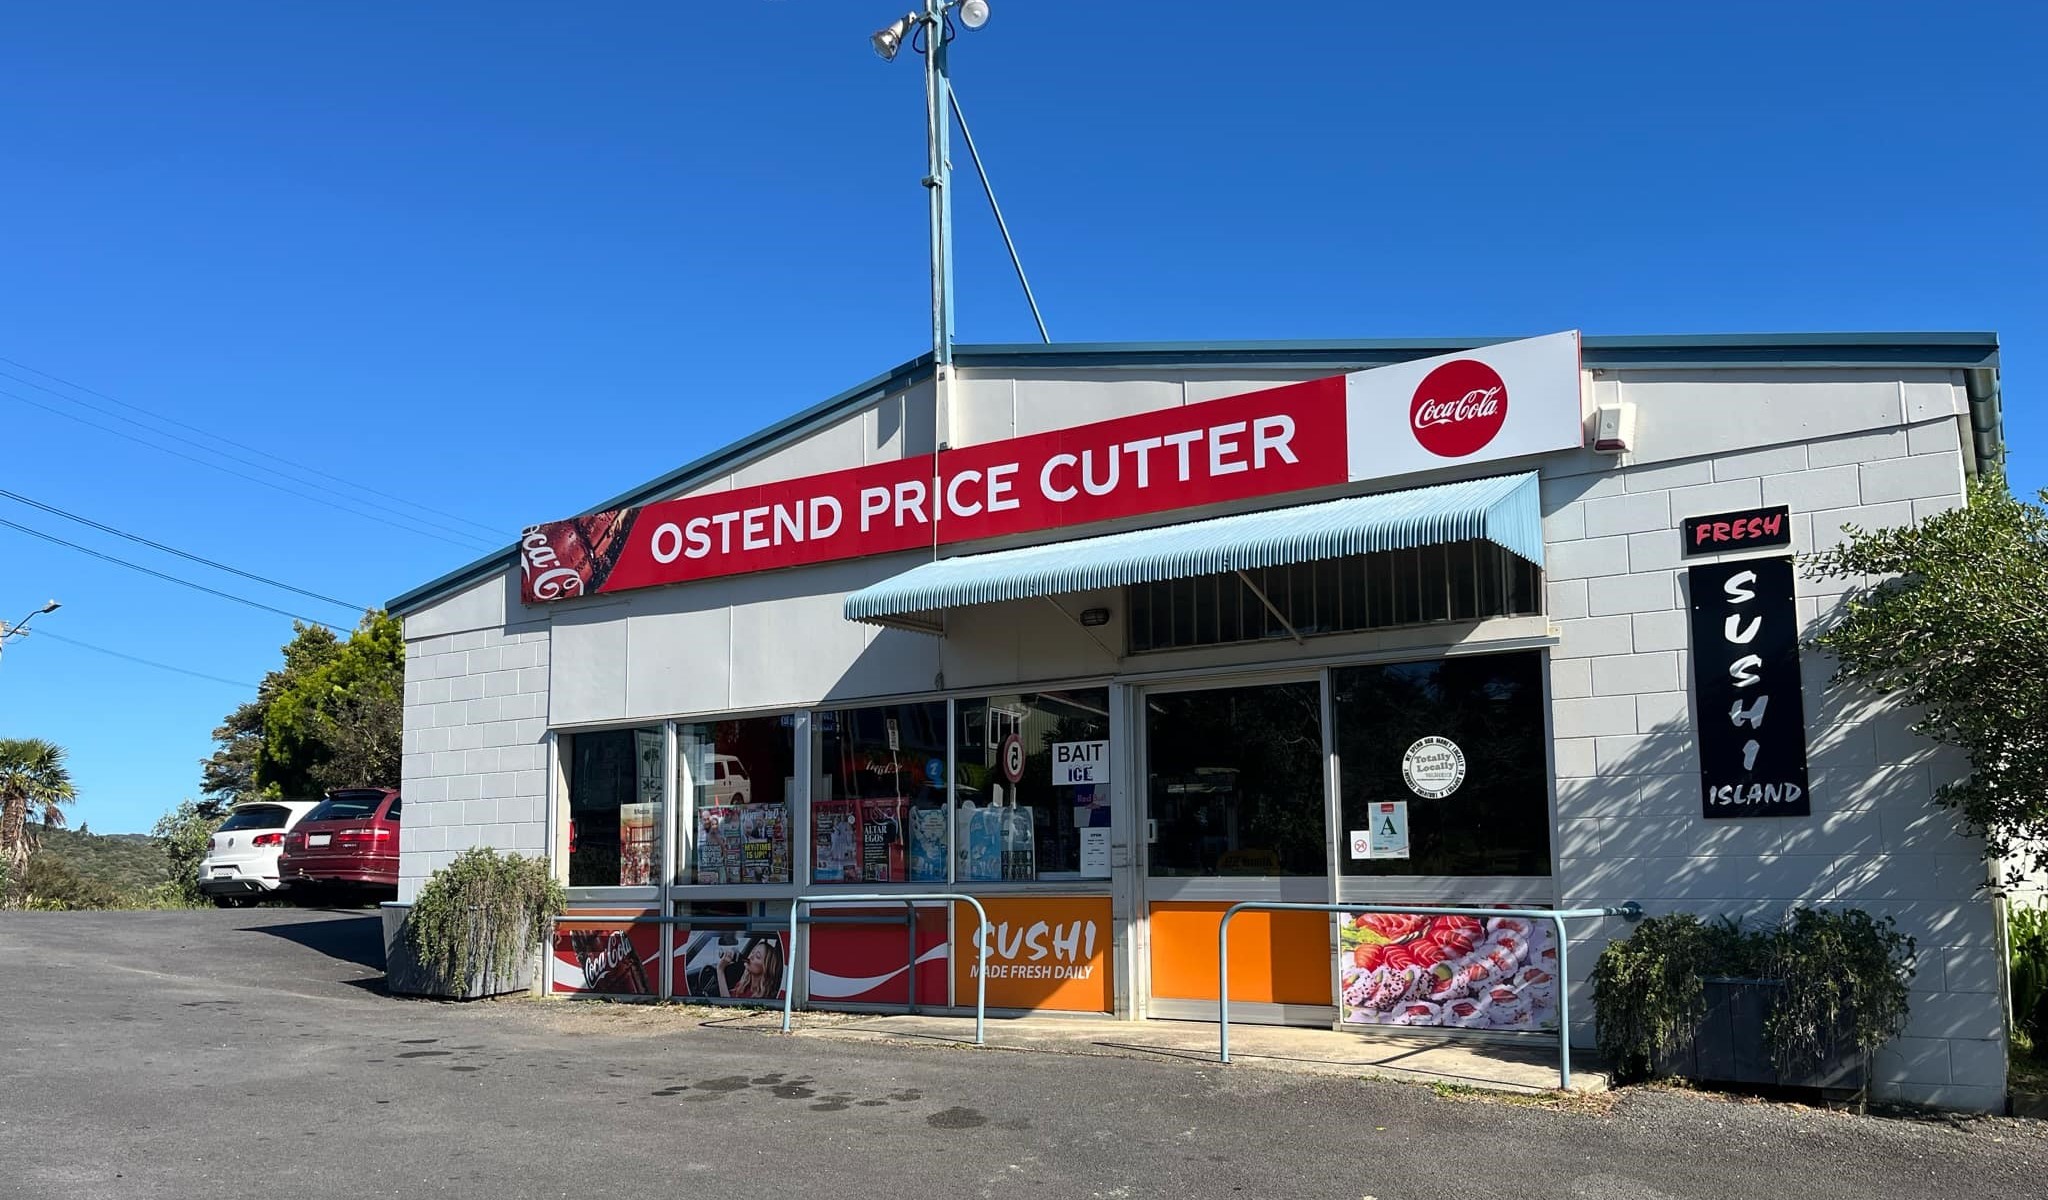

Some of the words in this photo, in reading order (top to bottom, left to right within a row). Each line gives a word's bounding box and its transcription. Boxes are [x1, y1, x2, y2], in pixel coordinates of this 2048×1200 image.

[1415, 386, 1502, 428] Coca-Cola
[650, 495, 842, 564] OSTEND
[860, 462, 1020, 532] PRICE
[1040, 414, 1300, 502] CUTTER
[1696, 514, 1782, 545] FRESH
[1724, 570, 1769, 771] SUSHI
[1058, 744, 1103, 762] BAIT
[1414, 753, 1451, 763] Totally
[1068, 766, 1094, 782] ICE
[1417, 762, 1454, 773] Locally
[1709, 782, 1802, 805] ISLAND
[1380, 816, 1397, 835] A
[973, 920, 1096, 963] SUSHI
[970, 965, 1008, 979] MADE
[1010, 965, 1051, 979] FRESH
[1054, 966, 1094, 979] DAILY
